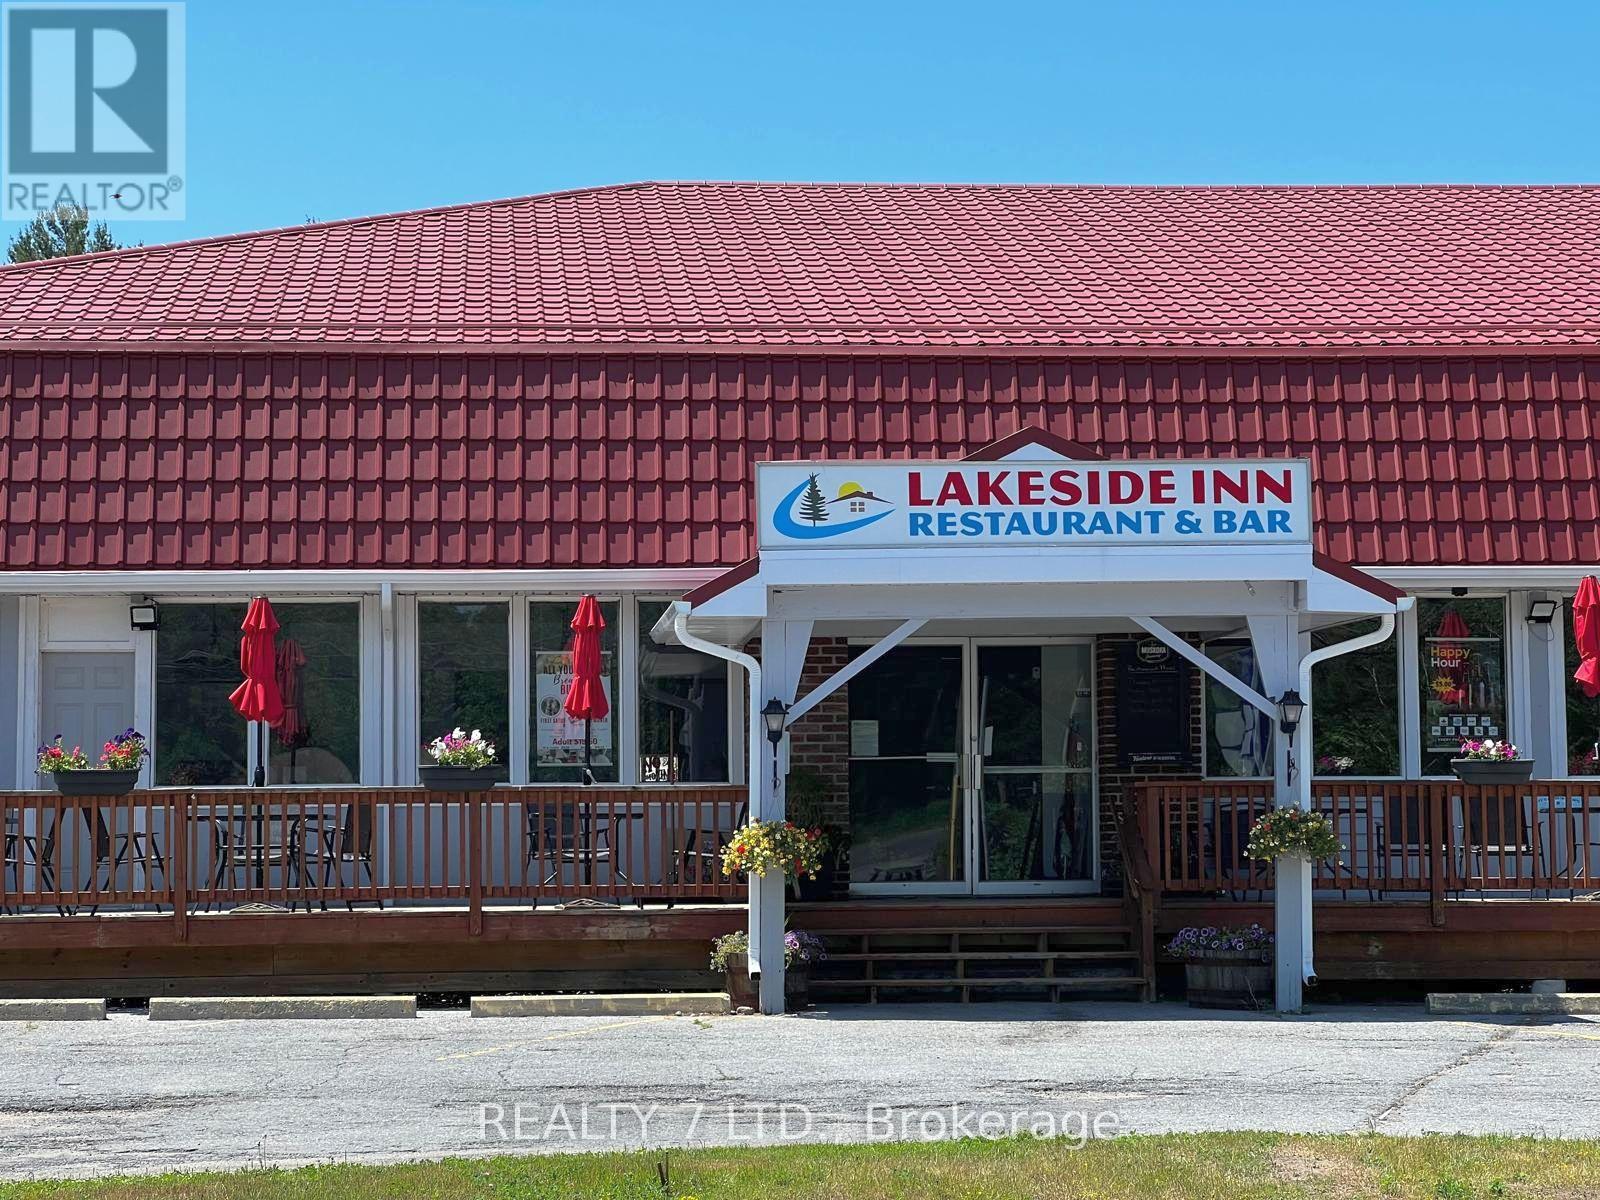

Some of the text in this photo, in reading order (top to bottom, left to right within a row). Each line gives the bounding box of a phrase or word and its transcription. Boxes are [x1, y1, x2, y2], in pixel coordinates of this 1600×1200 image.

[908, 471, 1292, 506] LAKESIDE INN
[908, 507, 1293, 538] RESTAURANT & BAR
[1431, 647, 1471, 659] Happy
[1431, 658, 1461, 667] Hour
